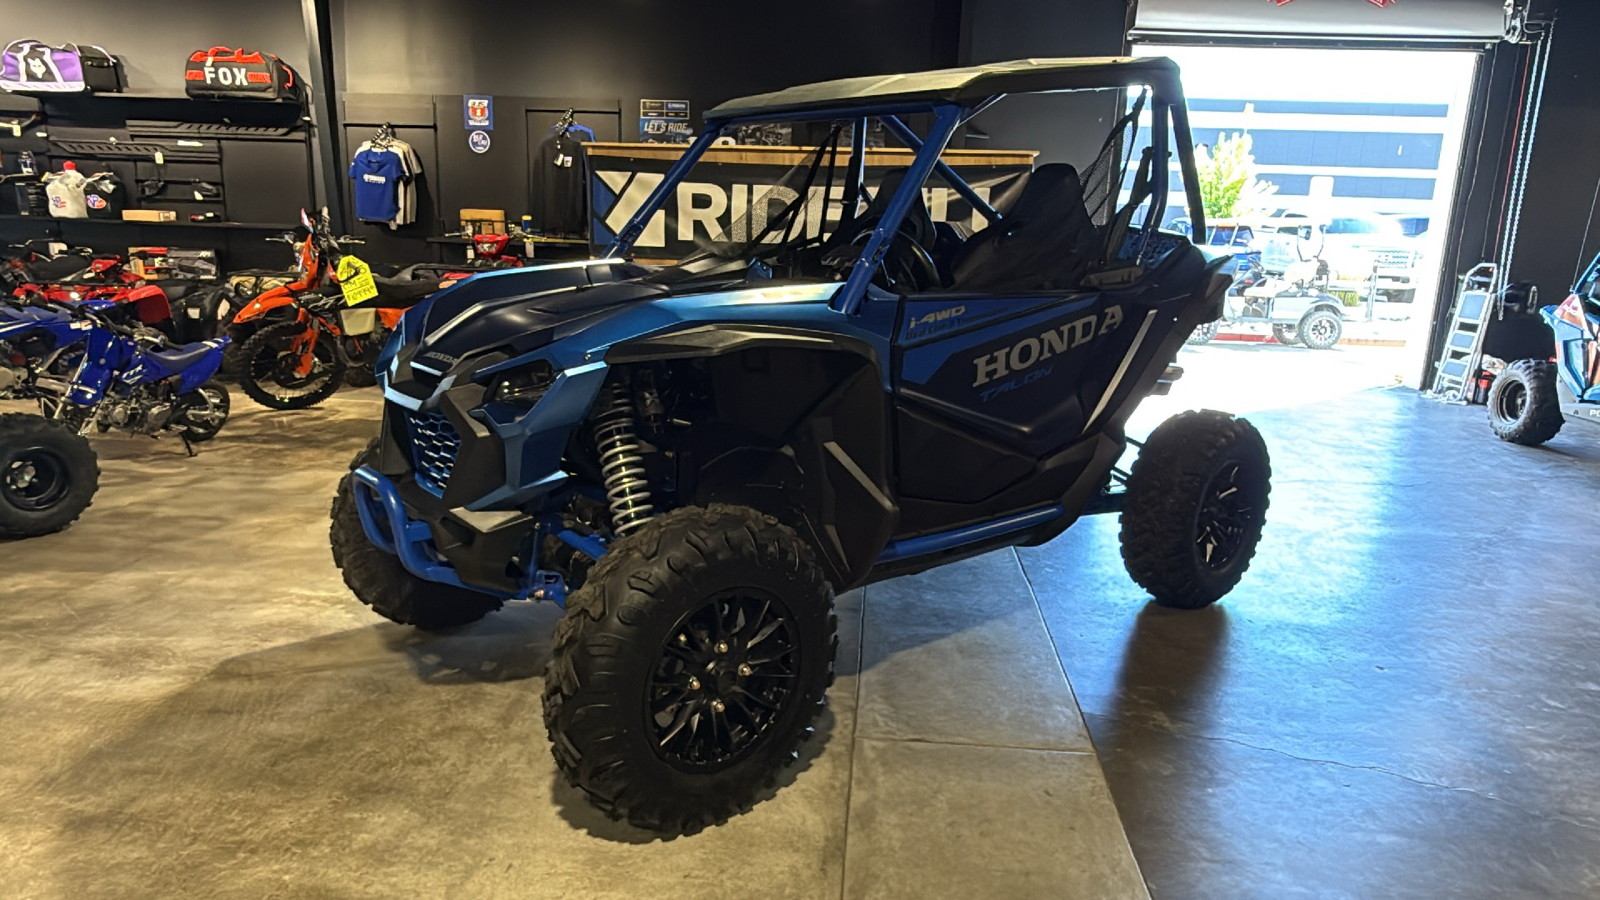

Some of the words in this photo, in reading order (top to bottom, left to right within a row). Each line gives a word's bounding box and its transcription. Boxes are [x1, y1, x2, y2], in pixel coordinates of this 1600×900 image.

[203, 66, 249, 86] FOX
[643, 121, 667, 132] LET'S
[668, 122, 688, 132] RIDE
[972, 304, 1124, 388] HONDA
[979, 365, 1053, 402] TALON
